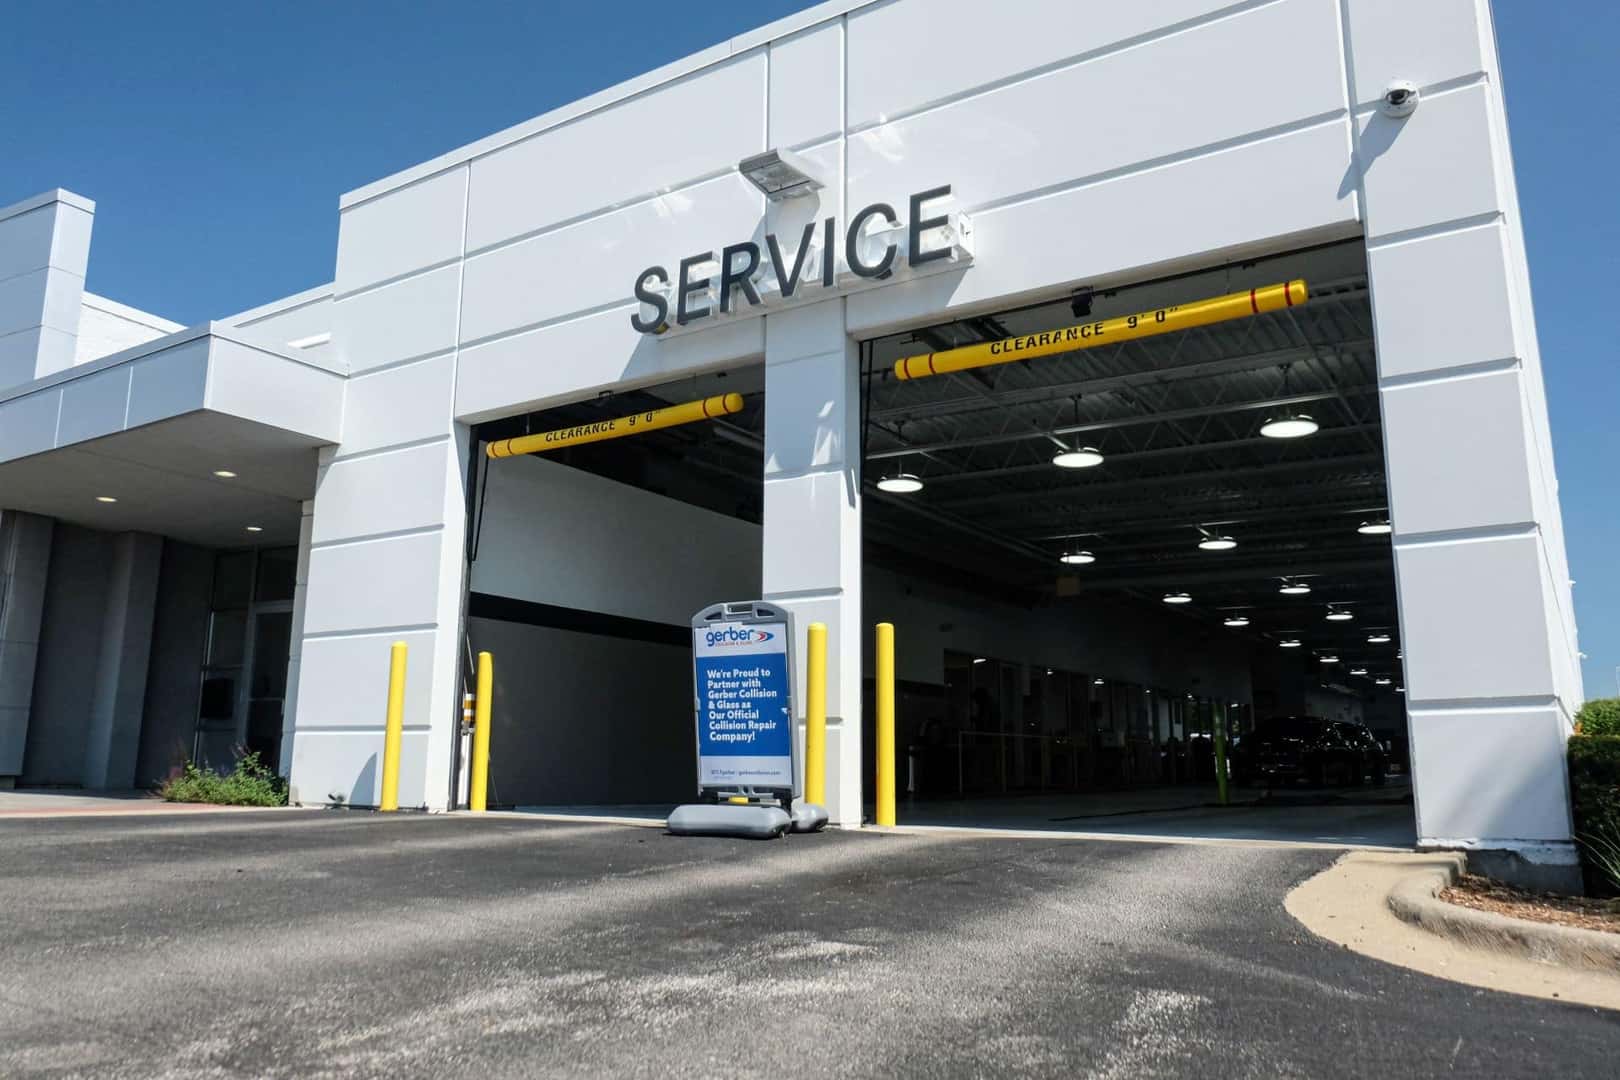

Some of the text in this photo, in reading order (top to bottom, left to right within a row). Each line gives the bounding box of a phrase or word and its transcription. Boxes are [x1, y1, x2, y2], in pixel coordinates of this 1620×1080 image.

[631, 184, 952, 335] SERVICE
[990, 322, 1105, 355] CLEARANCE
[1127, 314, 1145, 329] 9'
[545, 420, 616, 443] CLEARANCE
[706, 626, 755, 647] gerber
[707, 667, 771, 678] We're Proud to
[708, 678, 761, 688] Partner with
[708, 688, 777, 699] Gerber Collision
[716, 699, 740, 709] Glass
[709, 709, 759, 719] Our Official
[709, 720, 776, 731] Collision Repair
[709, 731, 755, 743] Company!
